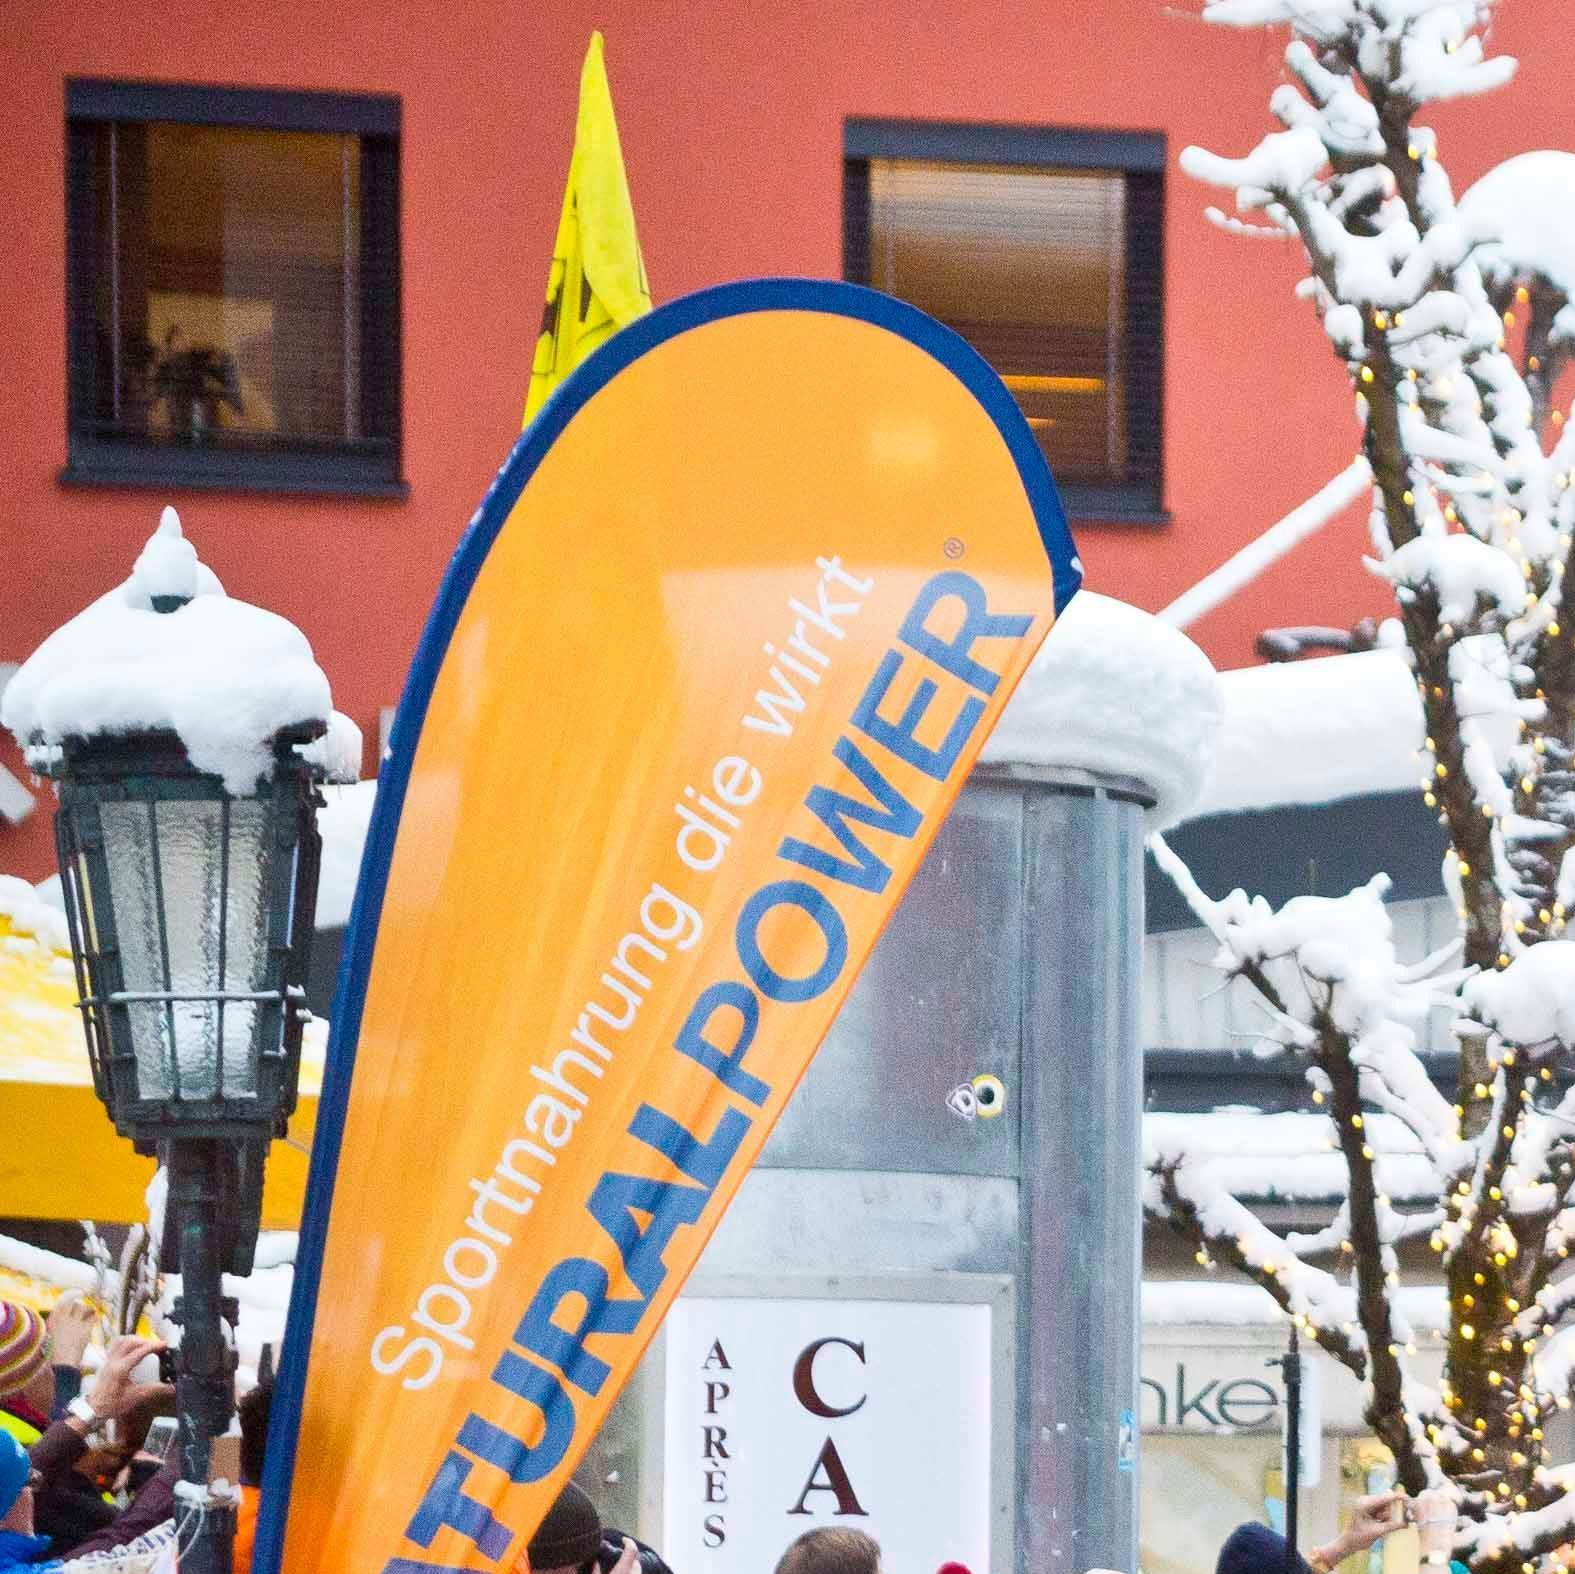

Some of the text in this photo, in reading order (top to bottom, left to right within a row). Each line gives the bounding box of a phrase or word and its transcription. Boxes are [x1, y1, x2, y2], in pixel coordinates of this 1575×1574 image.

[371, 550, 875, 1392] Sportnahrung die wirkt
